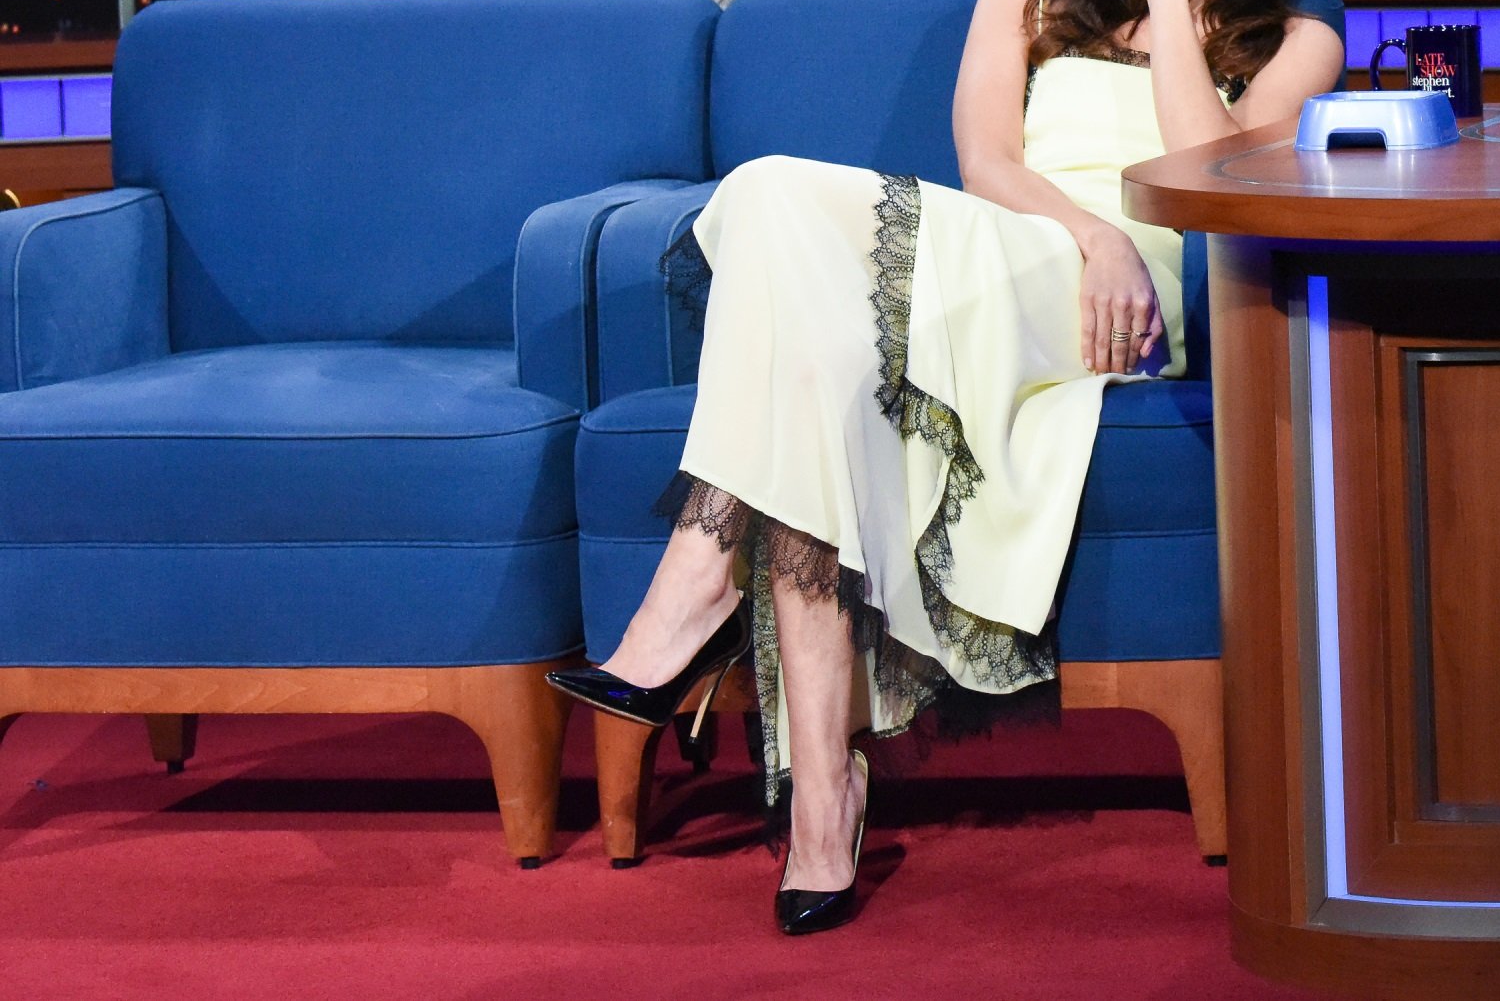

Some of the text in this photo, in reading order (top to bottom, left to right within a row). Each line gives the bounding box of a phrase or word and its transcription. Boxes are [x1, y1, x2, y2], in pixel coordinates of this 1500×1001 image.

[1415, 53, 1446, 66] LATE
[1420, 64, 1457, 78] SHOW
[1412, 73, 1450, 91] stephen
